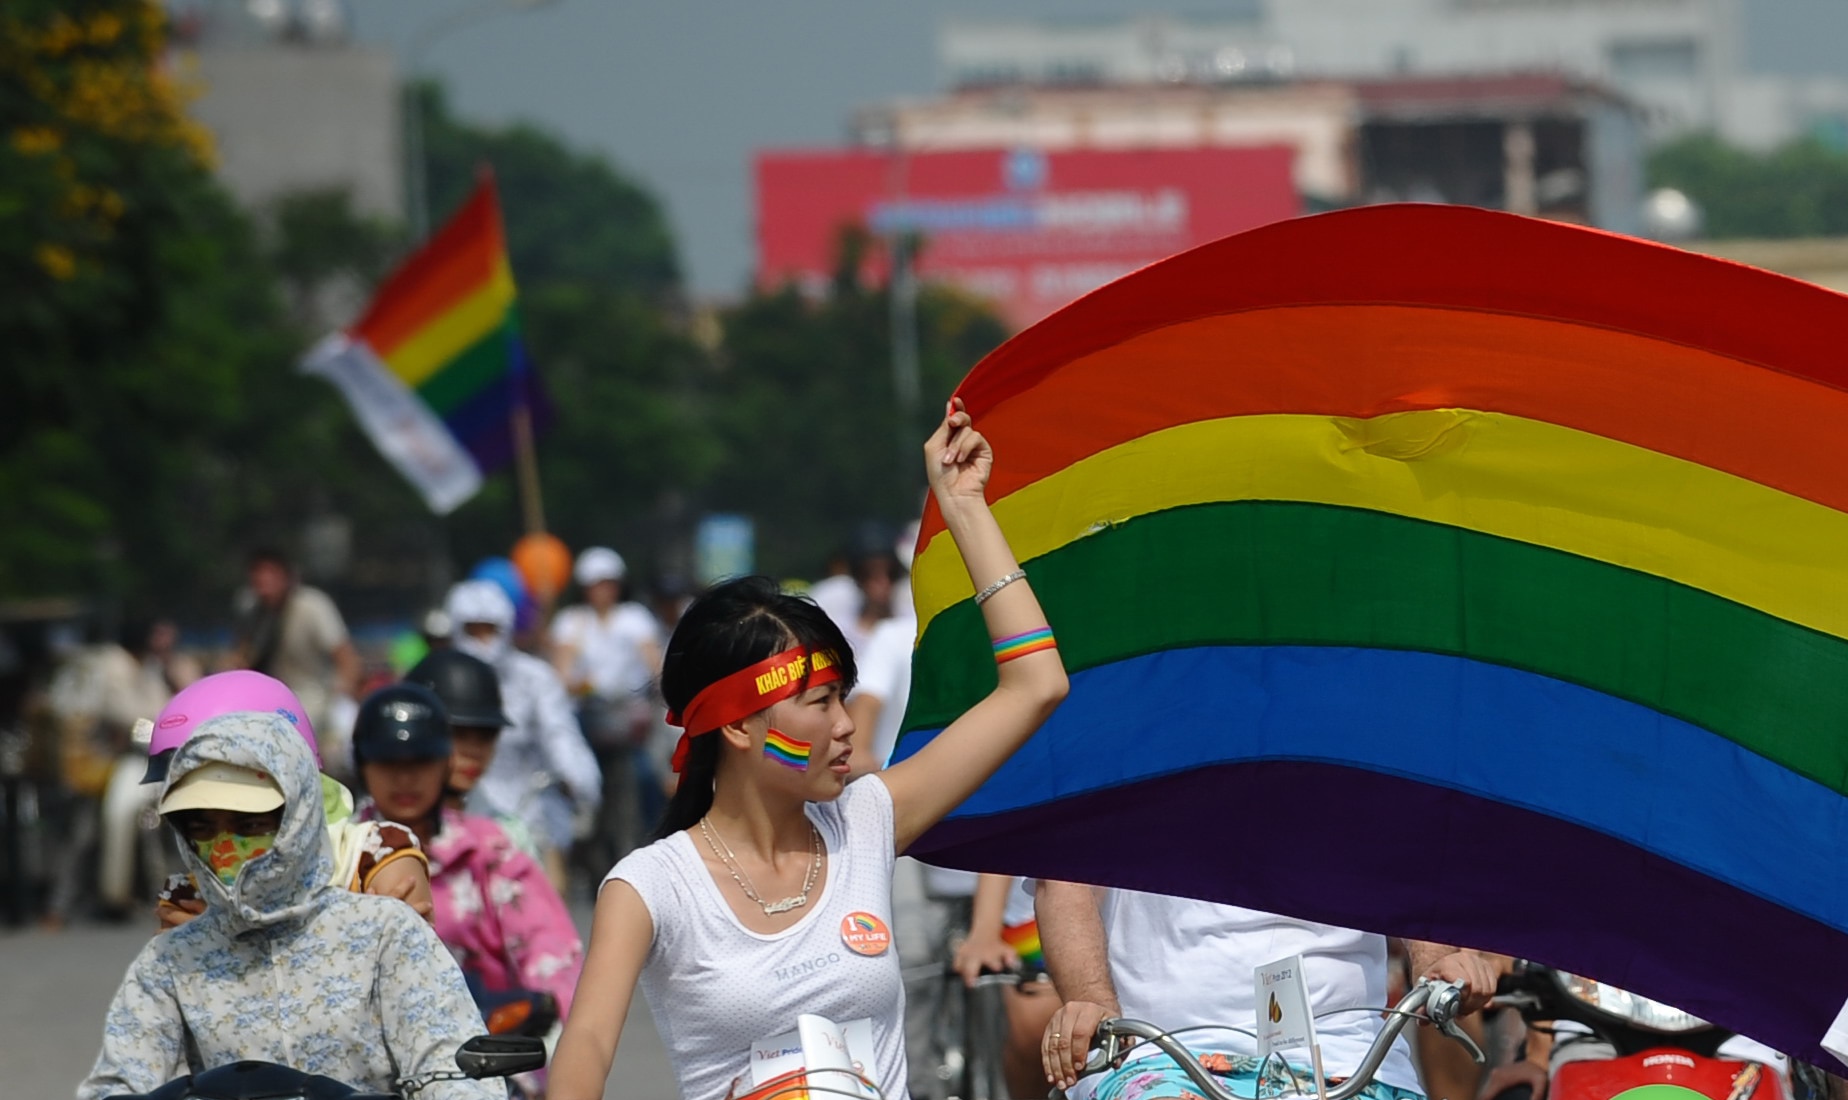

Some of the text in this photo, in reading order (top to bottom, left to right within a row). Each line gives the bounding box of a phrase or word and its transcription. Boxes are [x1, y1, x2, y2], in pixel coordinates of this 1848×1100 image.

[755, 666, 788, 695] KHÁC
[775, 953, 840, 981] MANGO
[757, 1049, 780, 1060] Viet
[1643, 1054, 1695, 1068] HONDA
